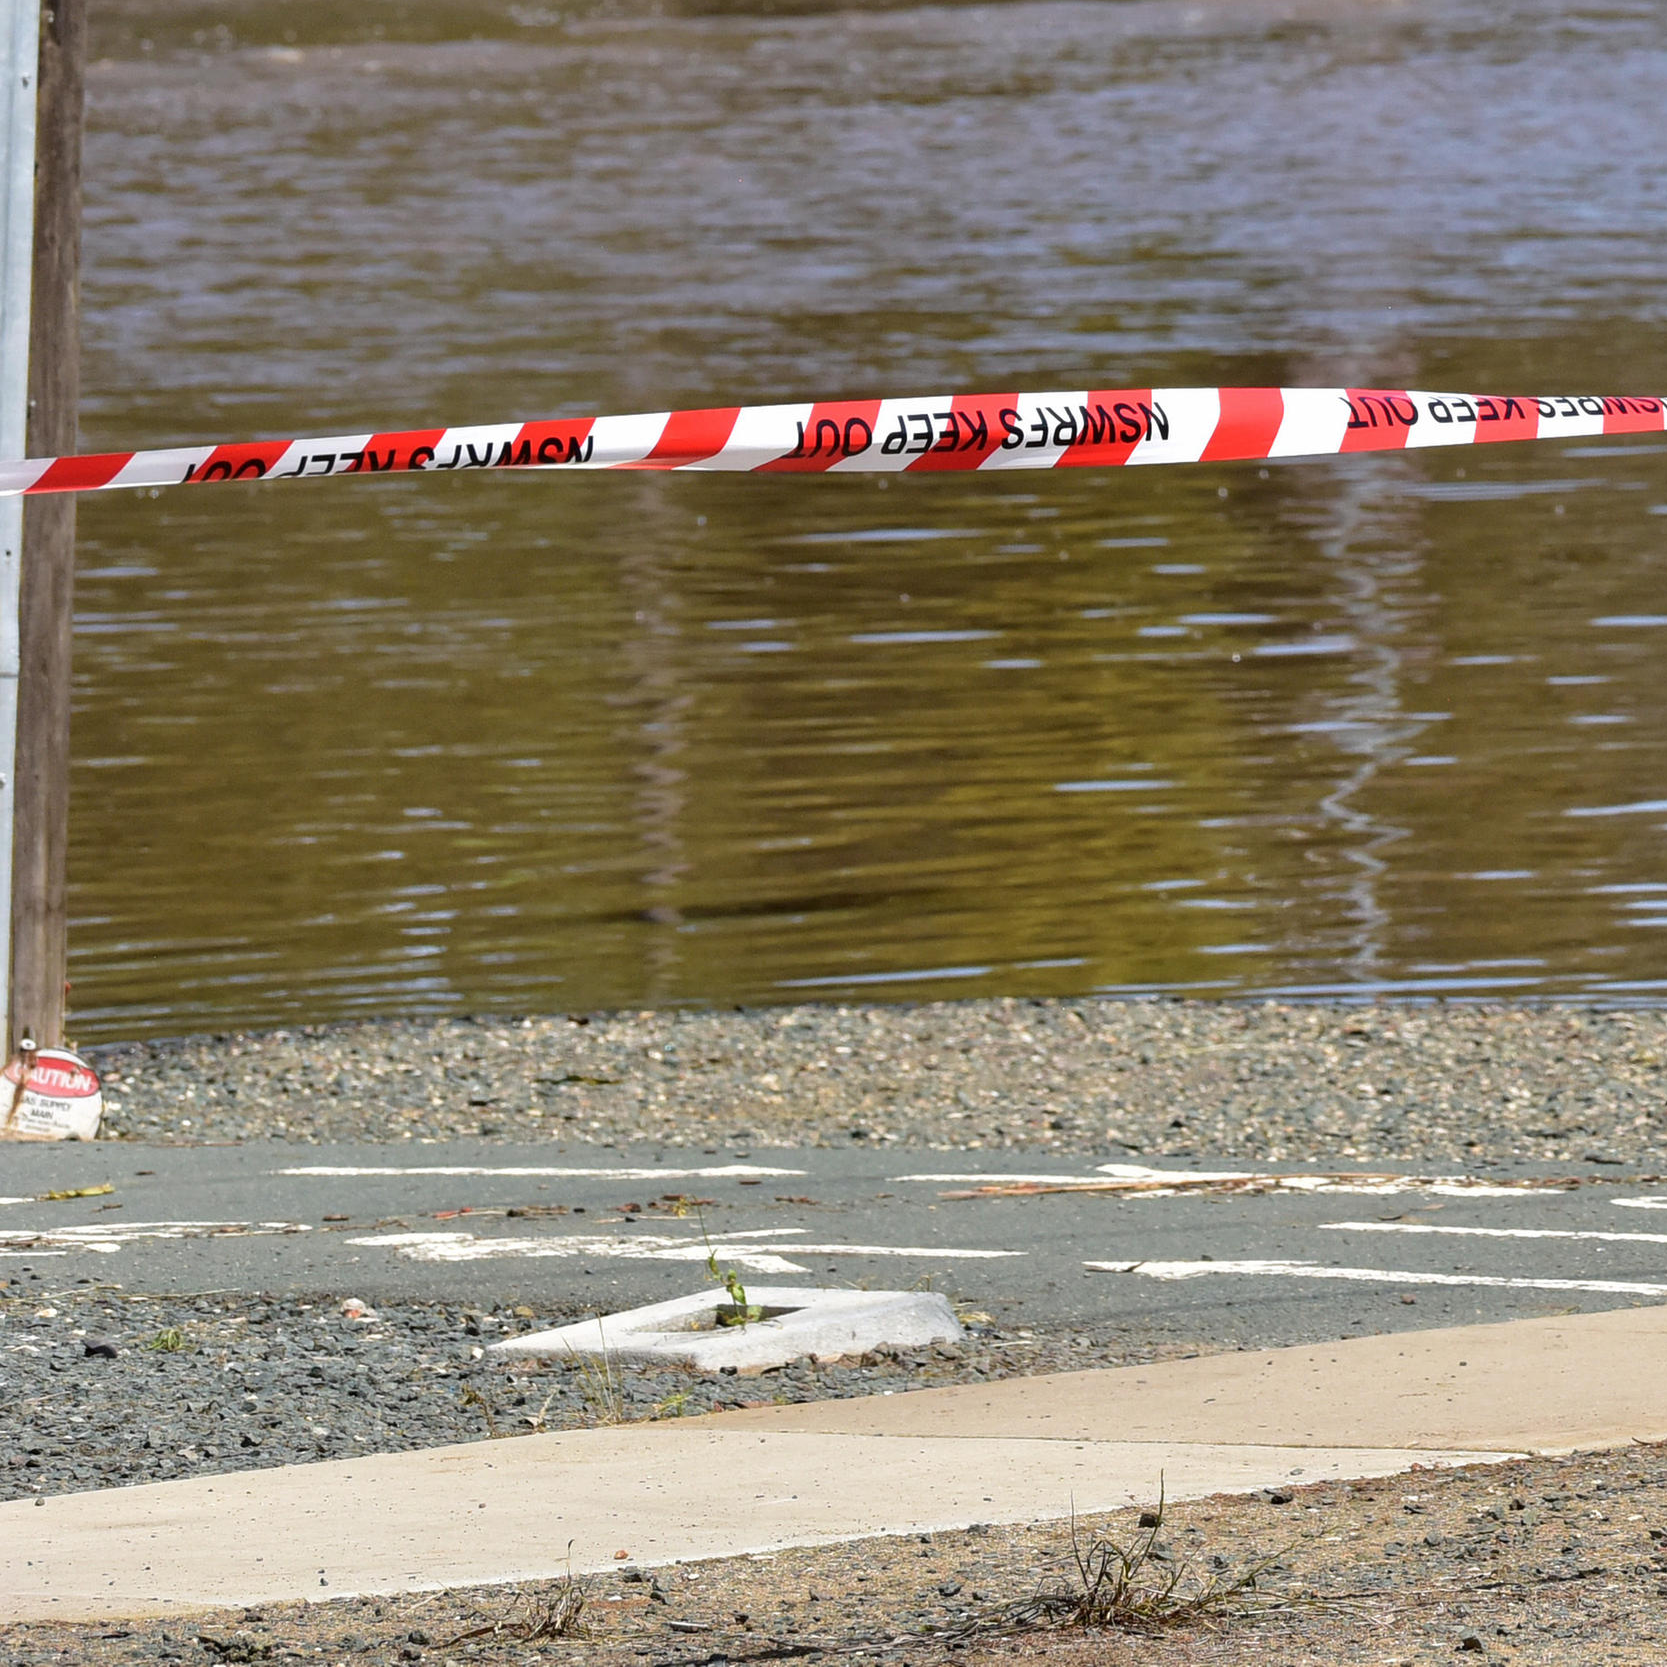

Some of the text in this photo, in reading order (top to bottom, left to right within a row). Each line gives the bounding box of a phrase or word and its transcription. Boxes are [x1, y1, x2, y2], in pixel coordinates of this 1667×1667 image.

[782, 402, 1169, 459] NSWRFS KEEP OUT
[1340, 397, 1420, 430] OUT
